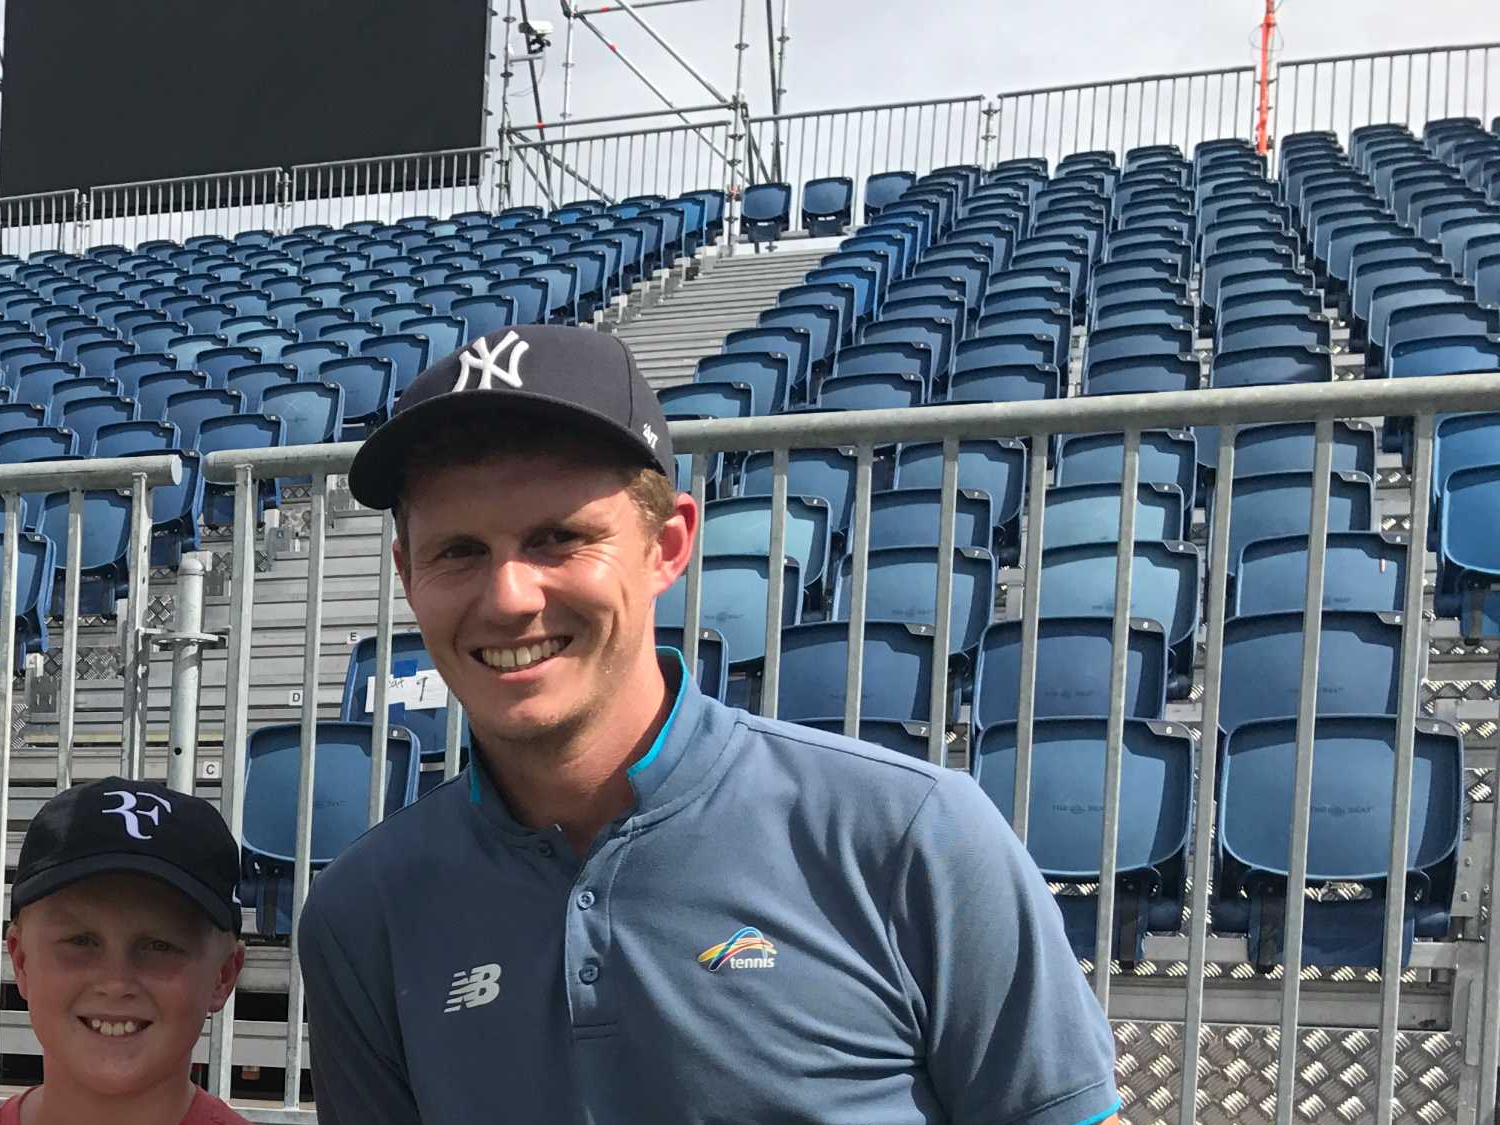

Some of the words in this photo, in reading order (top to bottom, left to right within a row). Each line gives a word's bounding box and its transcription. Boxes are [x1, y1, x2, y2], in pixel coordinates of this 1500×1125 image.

[350, 631, 357, 641] E
[292, 692, 301, 703] D
[205, 763, 216, 776] C
[102, 791, 172, 840] RF
[729, 956, 775, 969] tennis
